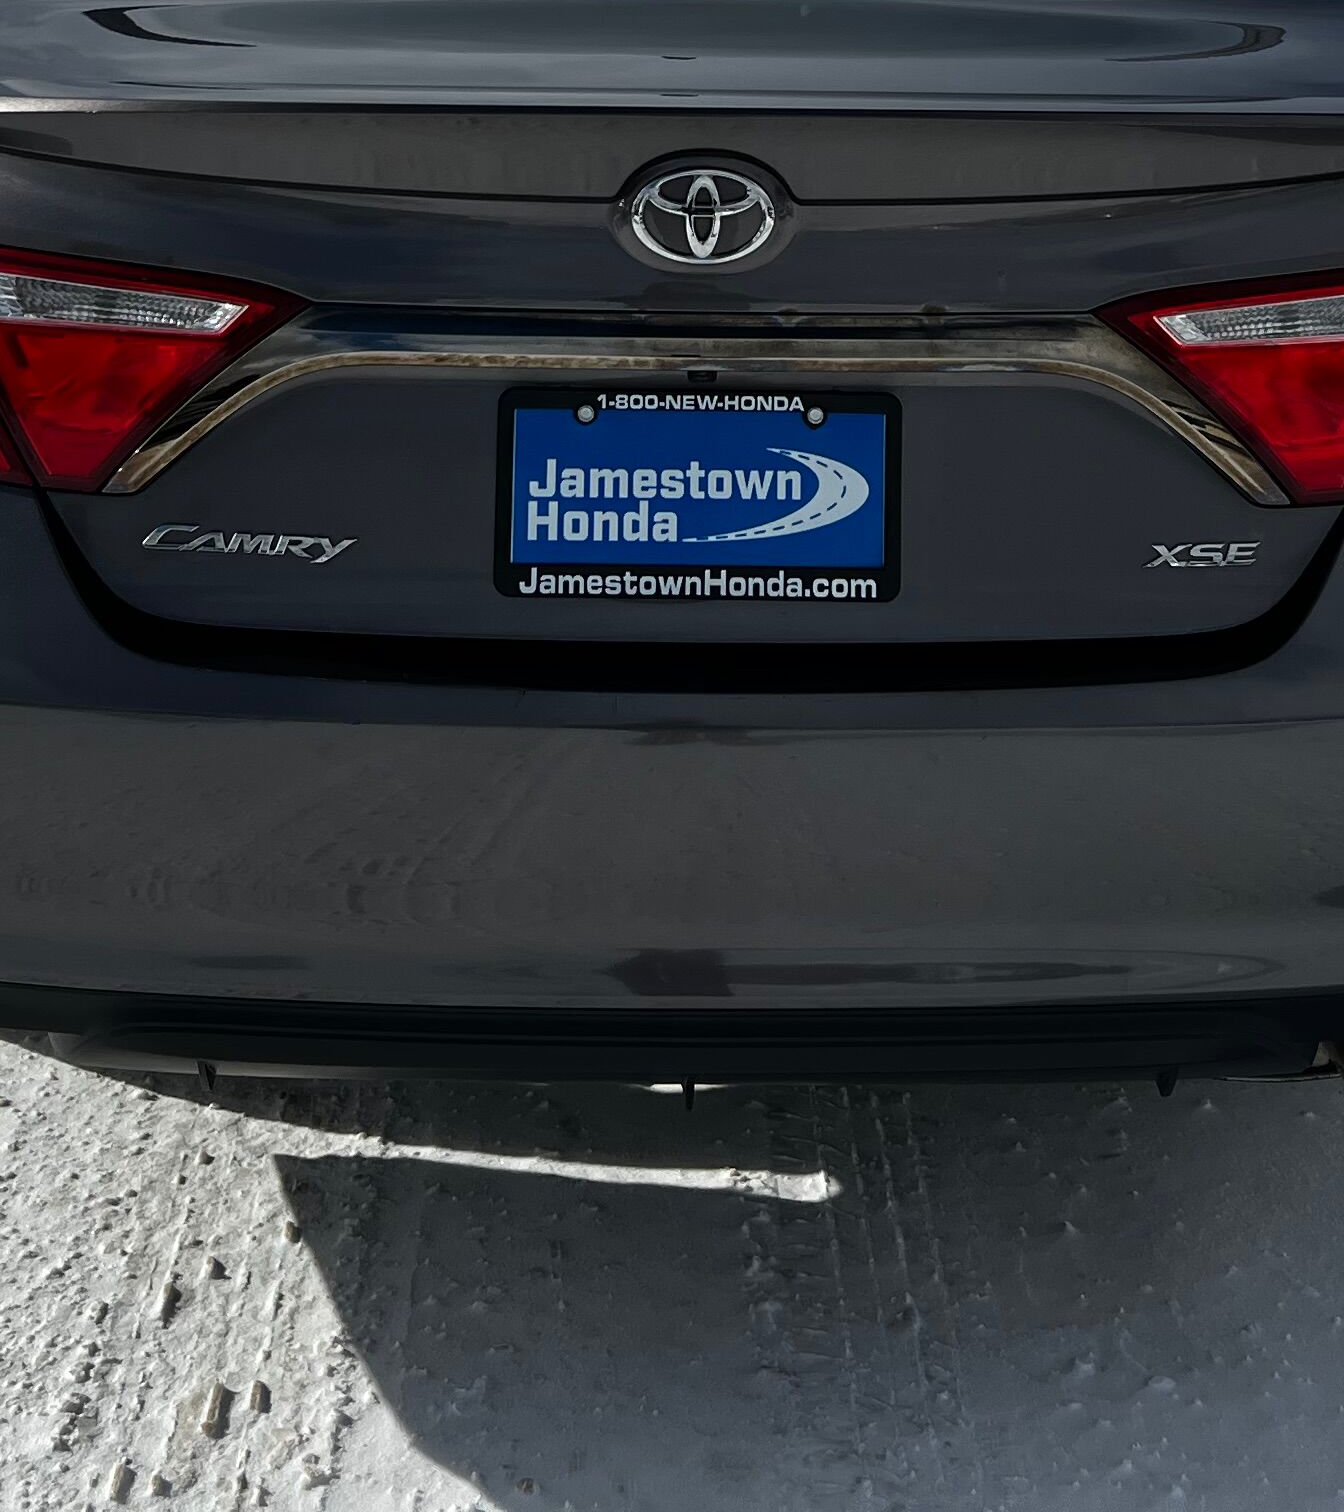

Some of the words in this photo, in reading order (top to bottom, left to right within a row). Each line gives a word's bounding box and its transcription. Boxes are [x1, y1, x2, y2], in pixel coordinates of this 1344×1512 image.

[596, 393, 805, 412] 1-800-NEW-HONDA
[529, 458, 802, 500] Jamestown
[526, 500, 678, 542] Honda
[142, 523, 358, 564] CAMRY
[1142, 541, 1261, 569] XSE
[519, 567, 877, 599] JamestownHonda.com
